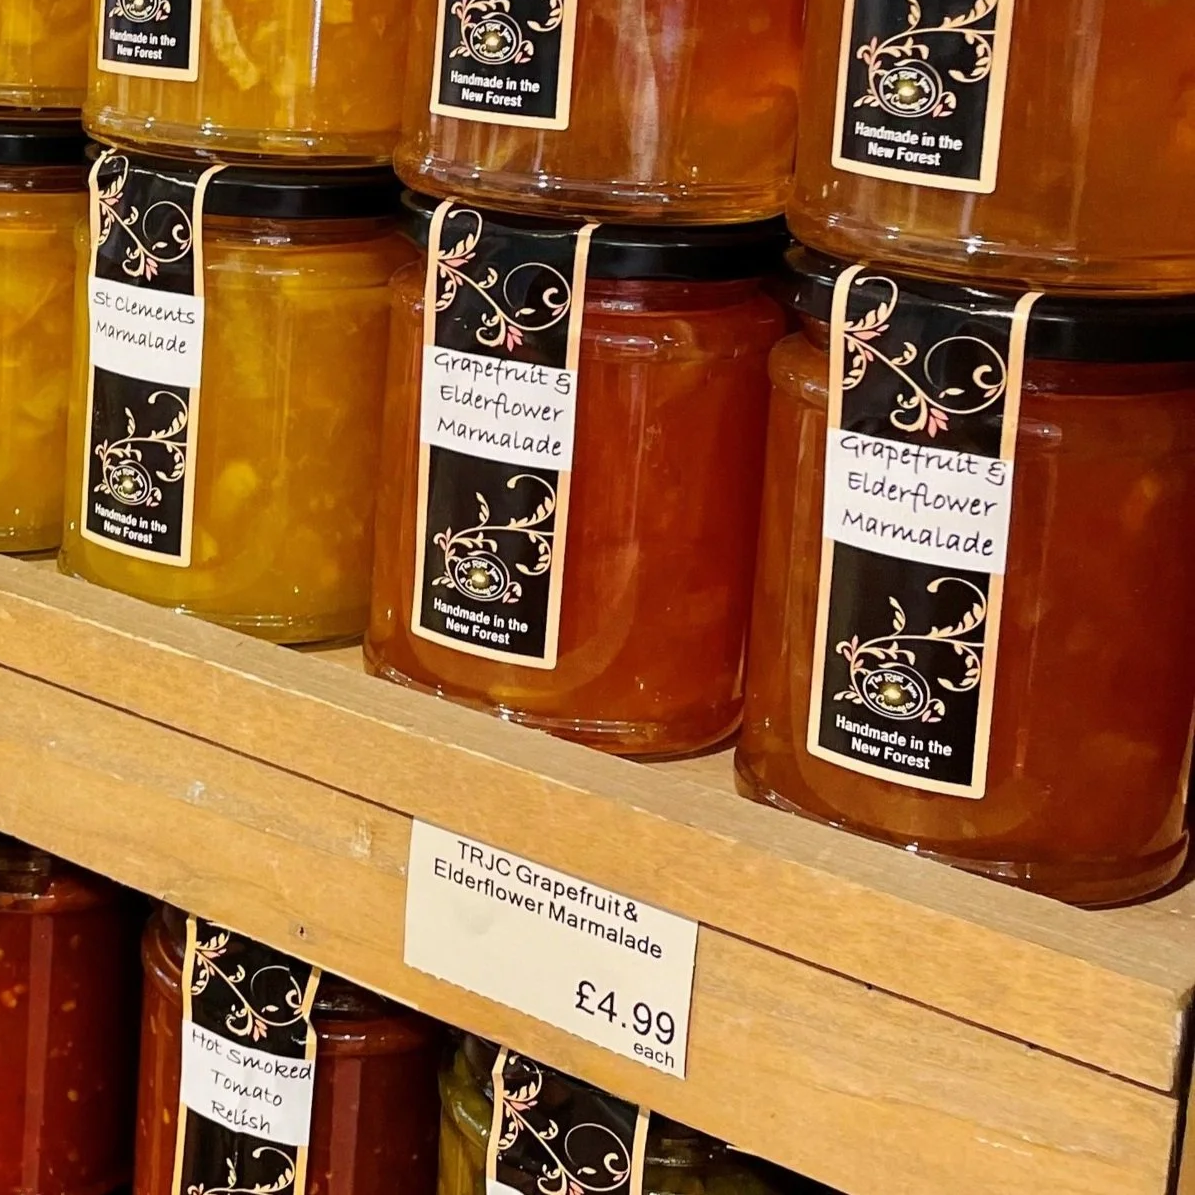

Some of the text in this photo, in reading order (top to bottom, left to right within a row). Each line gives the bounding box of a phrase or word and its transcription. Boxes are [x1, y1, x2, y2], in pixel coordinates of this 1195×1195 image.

[134, 45, 163, 60] Forest
[149, 33, 158, 45] in
[160, 34, 177, 47] the
[450, 69, 541, 94] Handmade in the
[461, 87, 523, 108] New Forest
[854, 120, 964, 151] Handmade in the
[867, 141, 942, 167] New Forest
[94, 290, 195, 325] St Clements
[96, 319, 187, 354] Marmalade
[434, 352, 571, 395] Grapefruit &
[440, 384, 564, 422] Elderflower
[437, 416, 562, 456] Marmalade
[840, 435, 1007, 486] Grapefruit &
[847, 471, 998, 517] Elderflower
[94, 502, 168, 534] Handmade in the
[103, 519, 153, 544] New Forest
[842, 508, 994, 557] Marmalade
[433, 596, 529, 634] Handmade in the
[445, 616, 511, 645] New Forest
[835, 713, 953, 757] Handmade in the
[850, 735, 931, 770] New Forest
[457, 840, 639, 923] TRJC Grapefruit &
[433, 857, 663, 960] Elderflower Marmalade
[574, 979, 676, 1046] £4.99
[192, 1028, 312, 1081] Hot Smoked
[632, 1040, 676, 1069] each
[211, 1068, 284, 1108] Tomato
[211, 1099, 272, 1135] Relish
